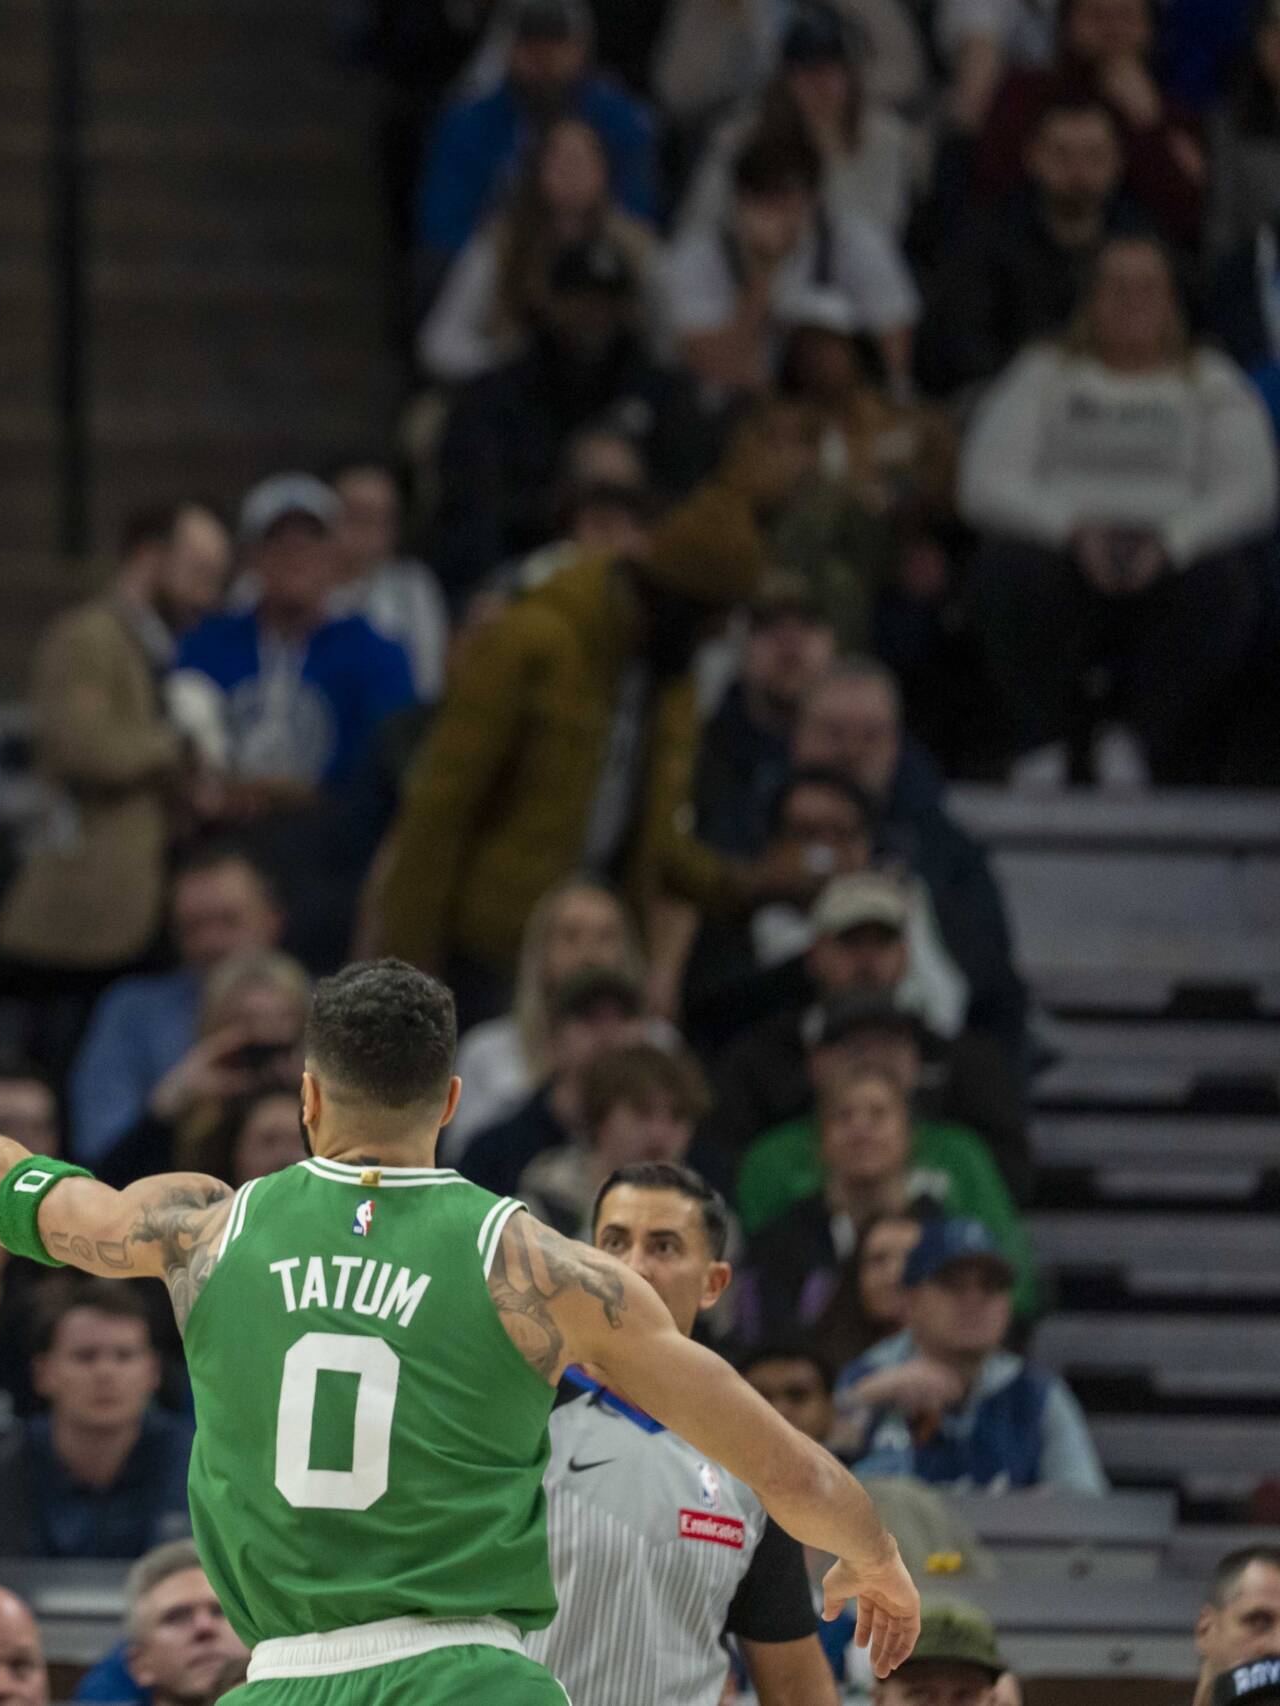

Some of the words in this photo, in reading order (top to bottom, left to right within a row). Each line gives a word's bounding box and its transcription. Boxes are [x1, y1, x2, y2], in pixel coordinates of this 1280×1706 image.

[269, 1256, 431, 1327] TATUM
[275, 1332, 400, 1511] 0
[681, 1514, 744, 1543] Emirates
